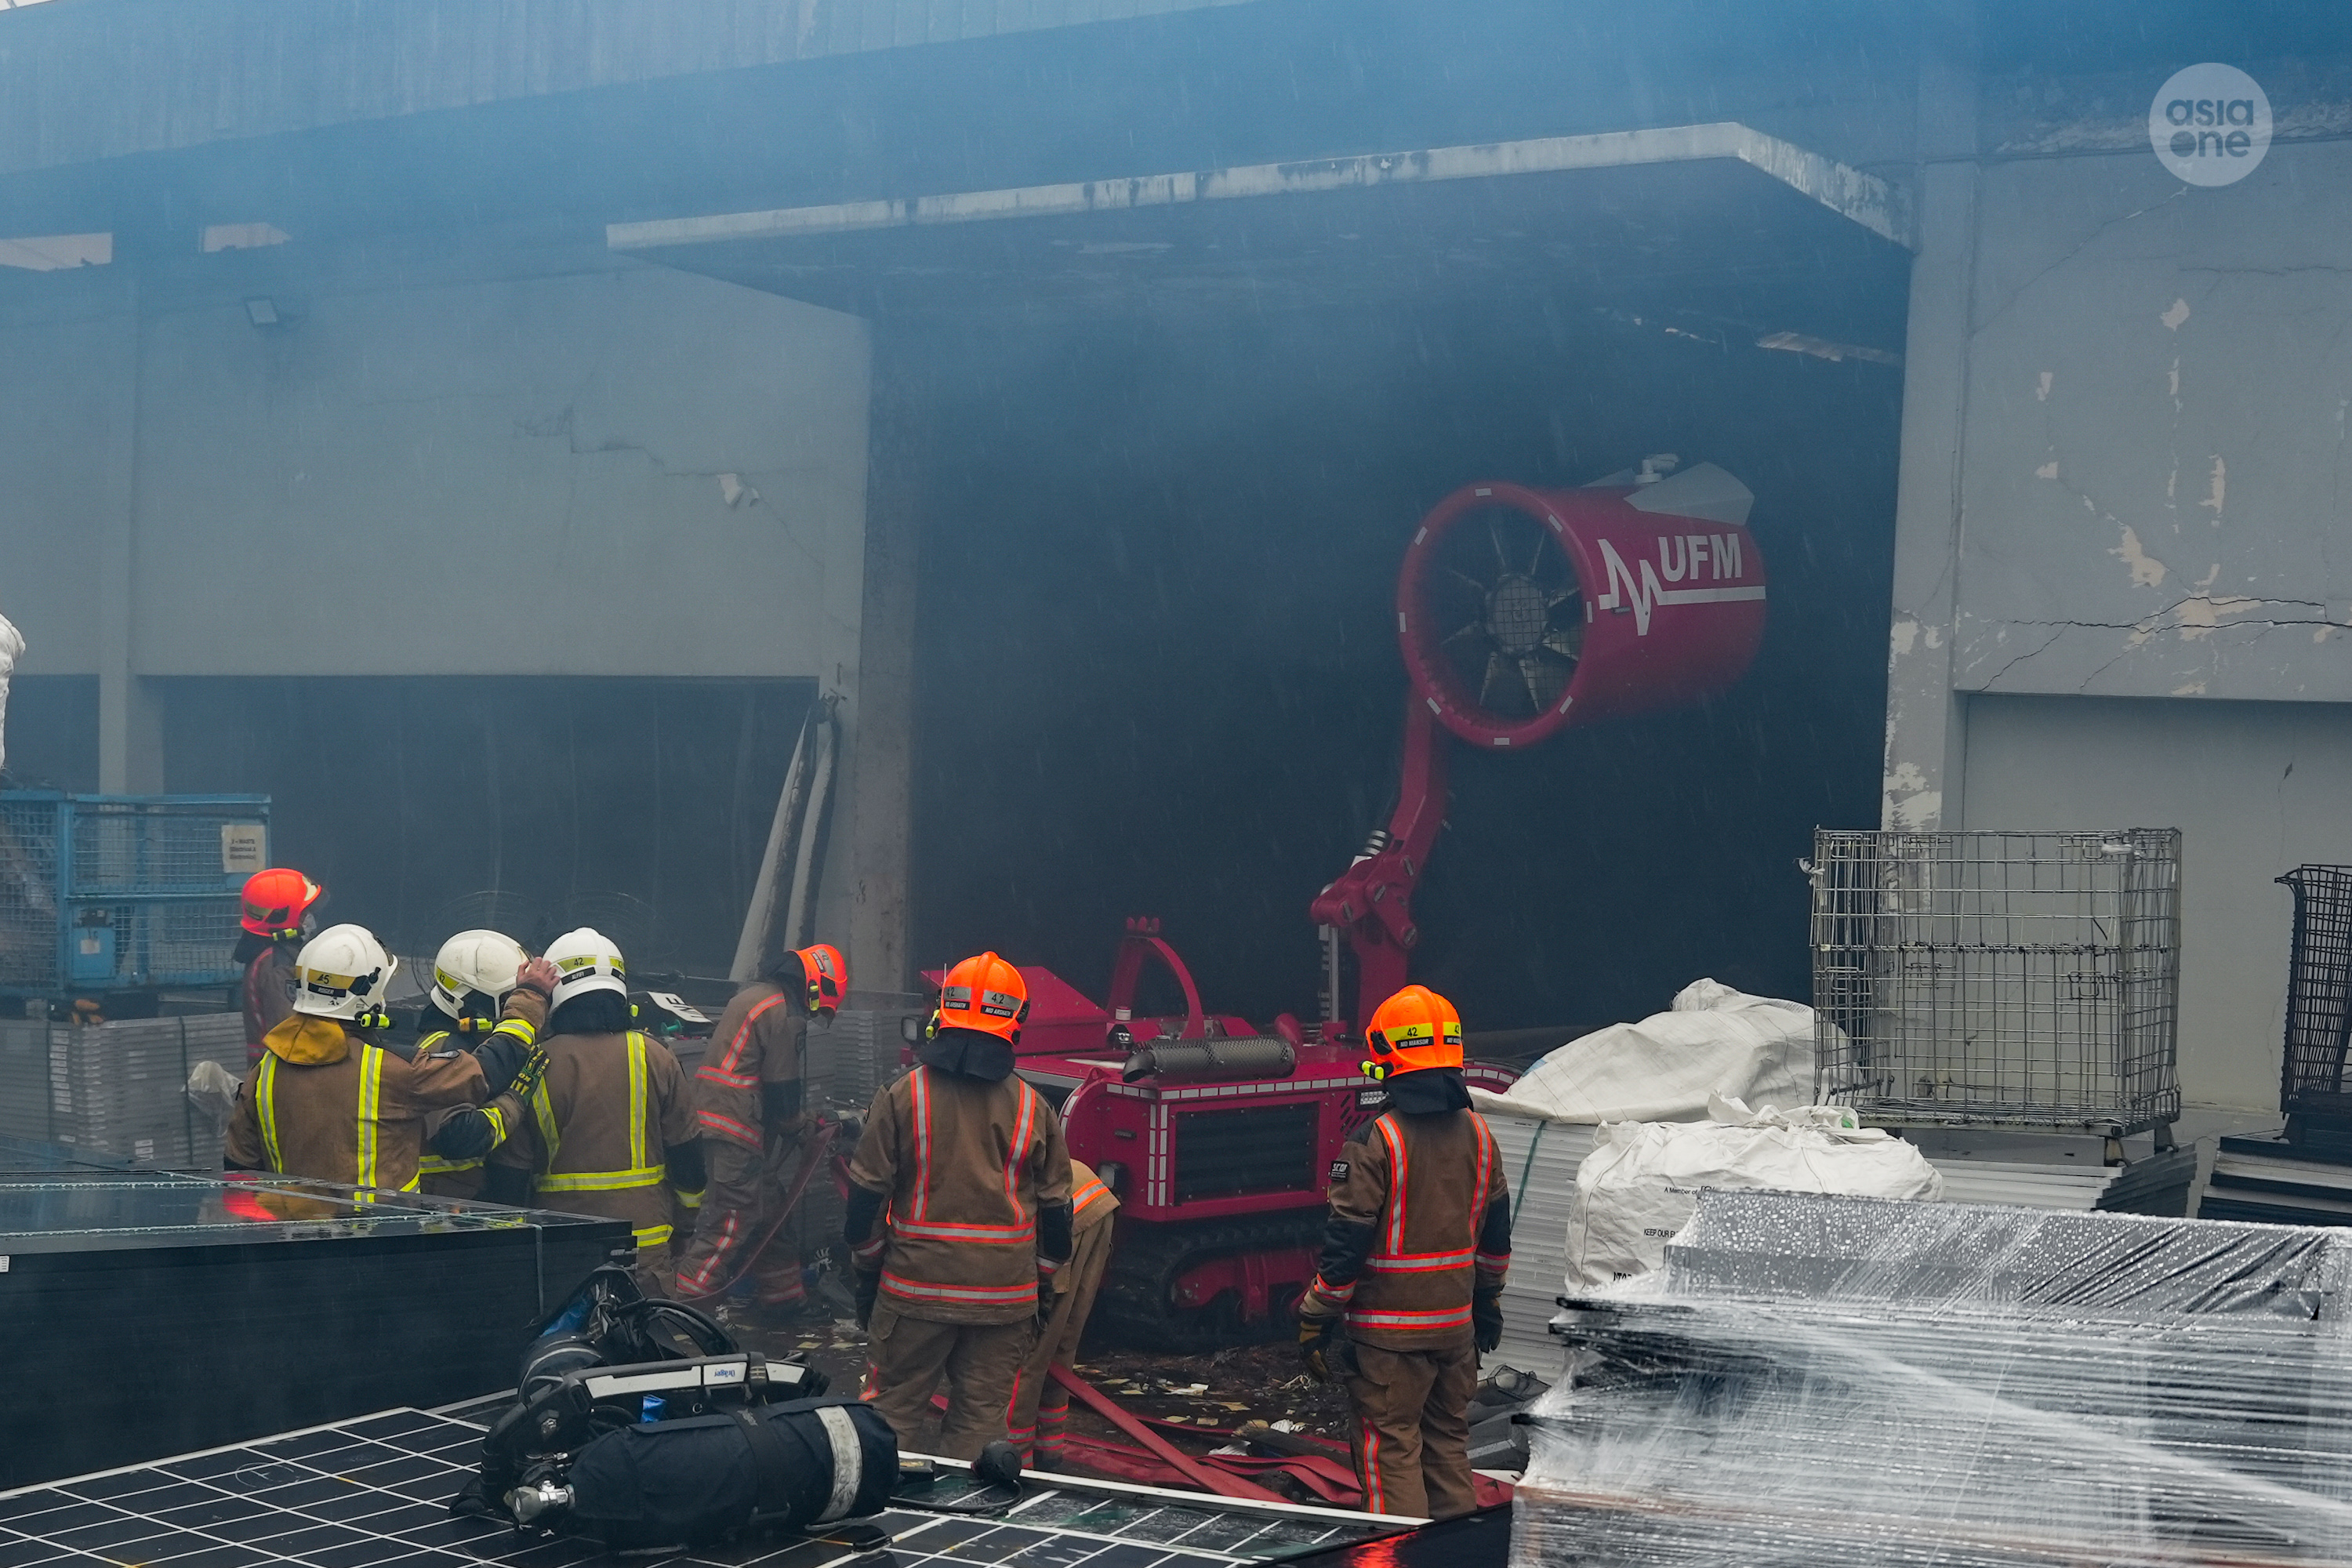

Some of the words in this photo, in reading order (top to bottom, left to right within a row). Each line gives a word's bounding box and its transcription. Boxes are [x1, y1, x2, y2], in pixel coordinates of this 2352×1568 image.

[1657, 533, 1742, 583] UFM
[574, 957, 584, 966] 42
[1407, 1027, 1418, 1036] 42
[1643, 1228, 1657, 1236] KEEP
[1657, 1229, 1669, 1238] OUR
